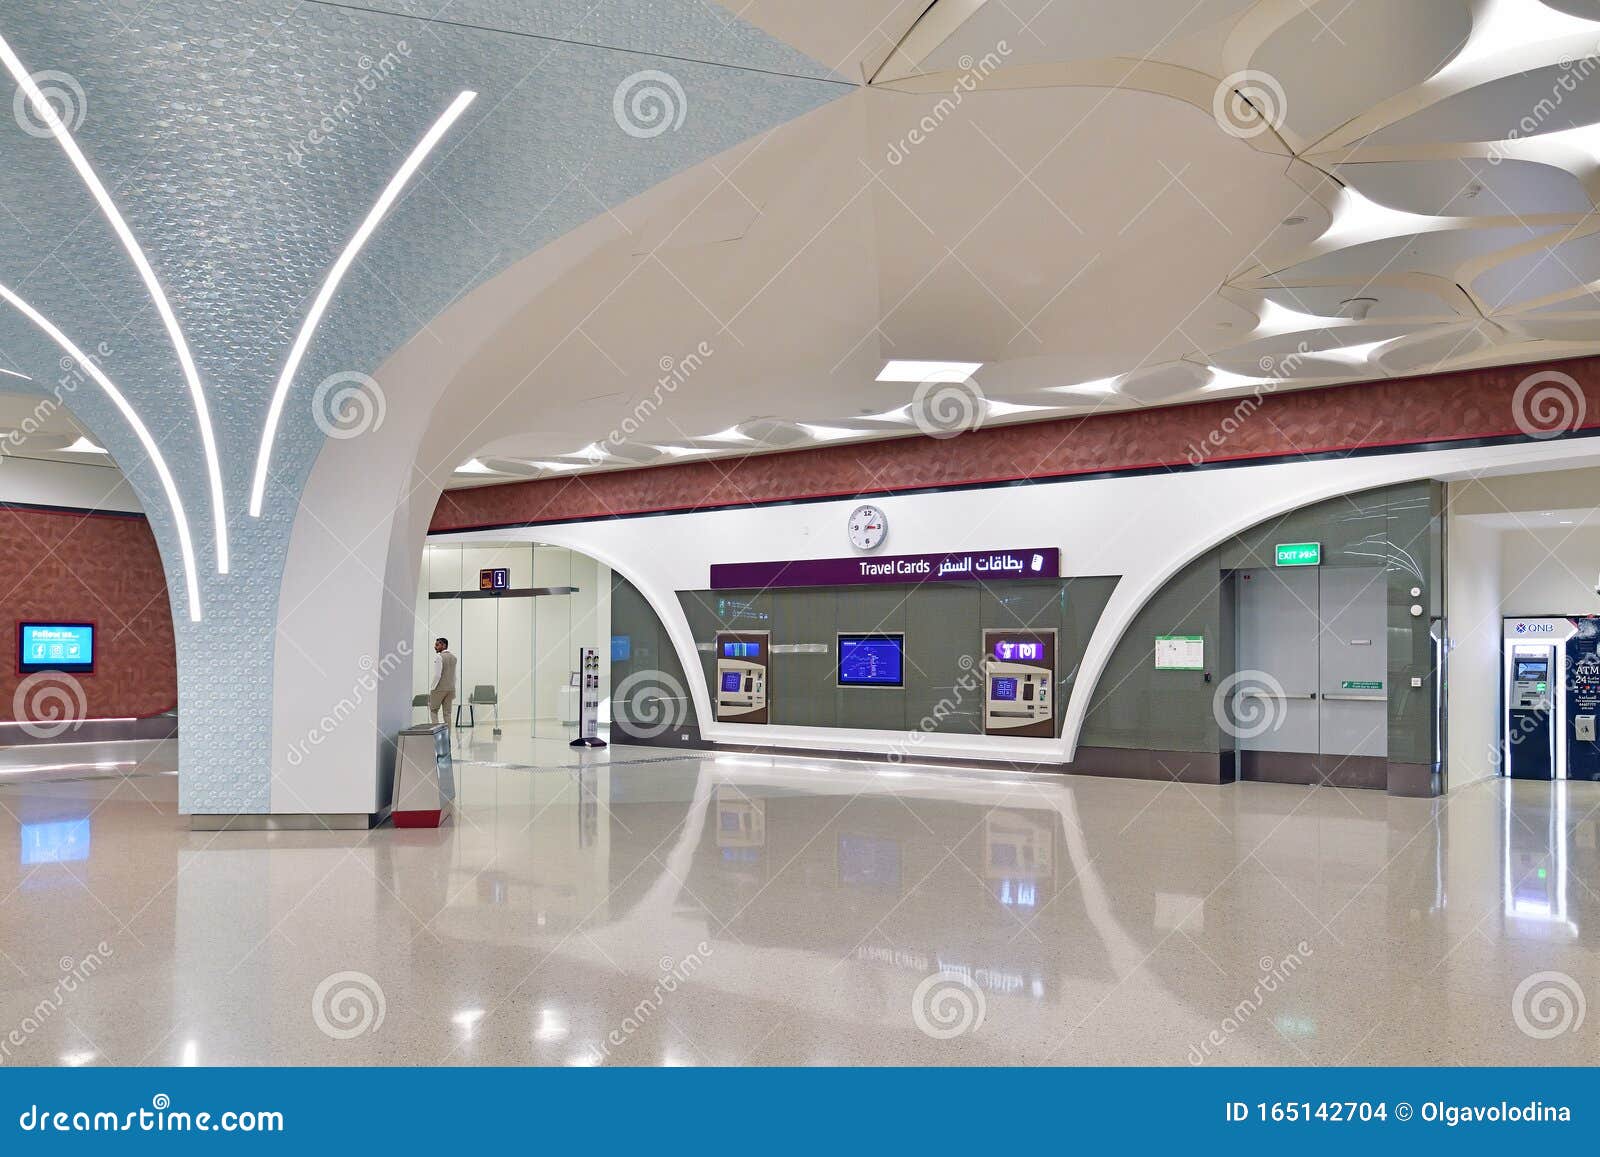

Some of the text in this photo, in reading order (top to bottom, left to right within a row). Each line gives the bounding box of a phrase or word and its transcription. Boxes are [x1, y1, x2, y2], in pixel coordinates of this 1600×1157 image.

[1278, 551, 1297, 560] EXIT
[860, 560, 930, 576] Travel Cards
[938, 555, 1024, 577] بطاقات السفر
[1528, 623, 1554, 632] QNB
[32, 630, 60, 639] Follow
[1576, 666, 1600, 675] ATM
[1575, 675, 1587, 684] 24
